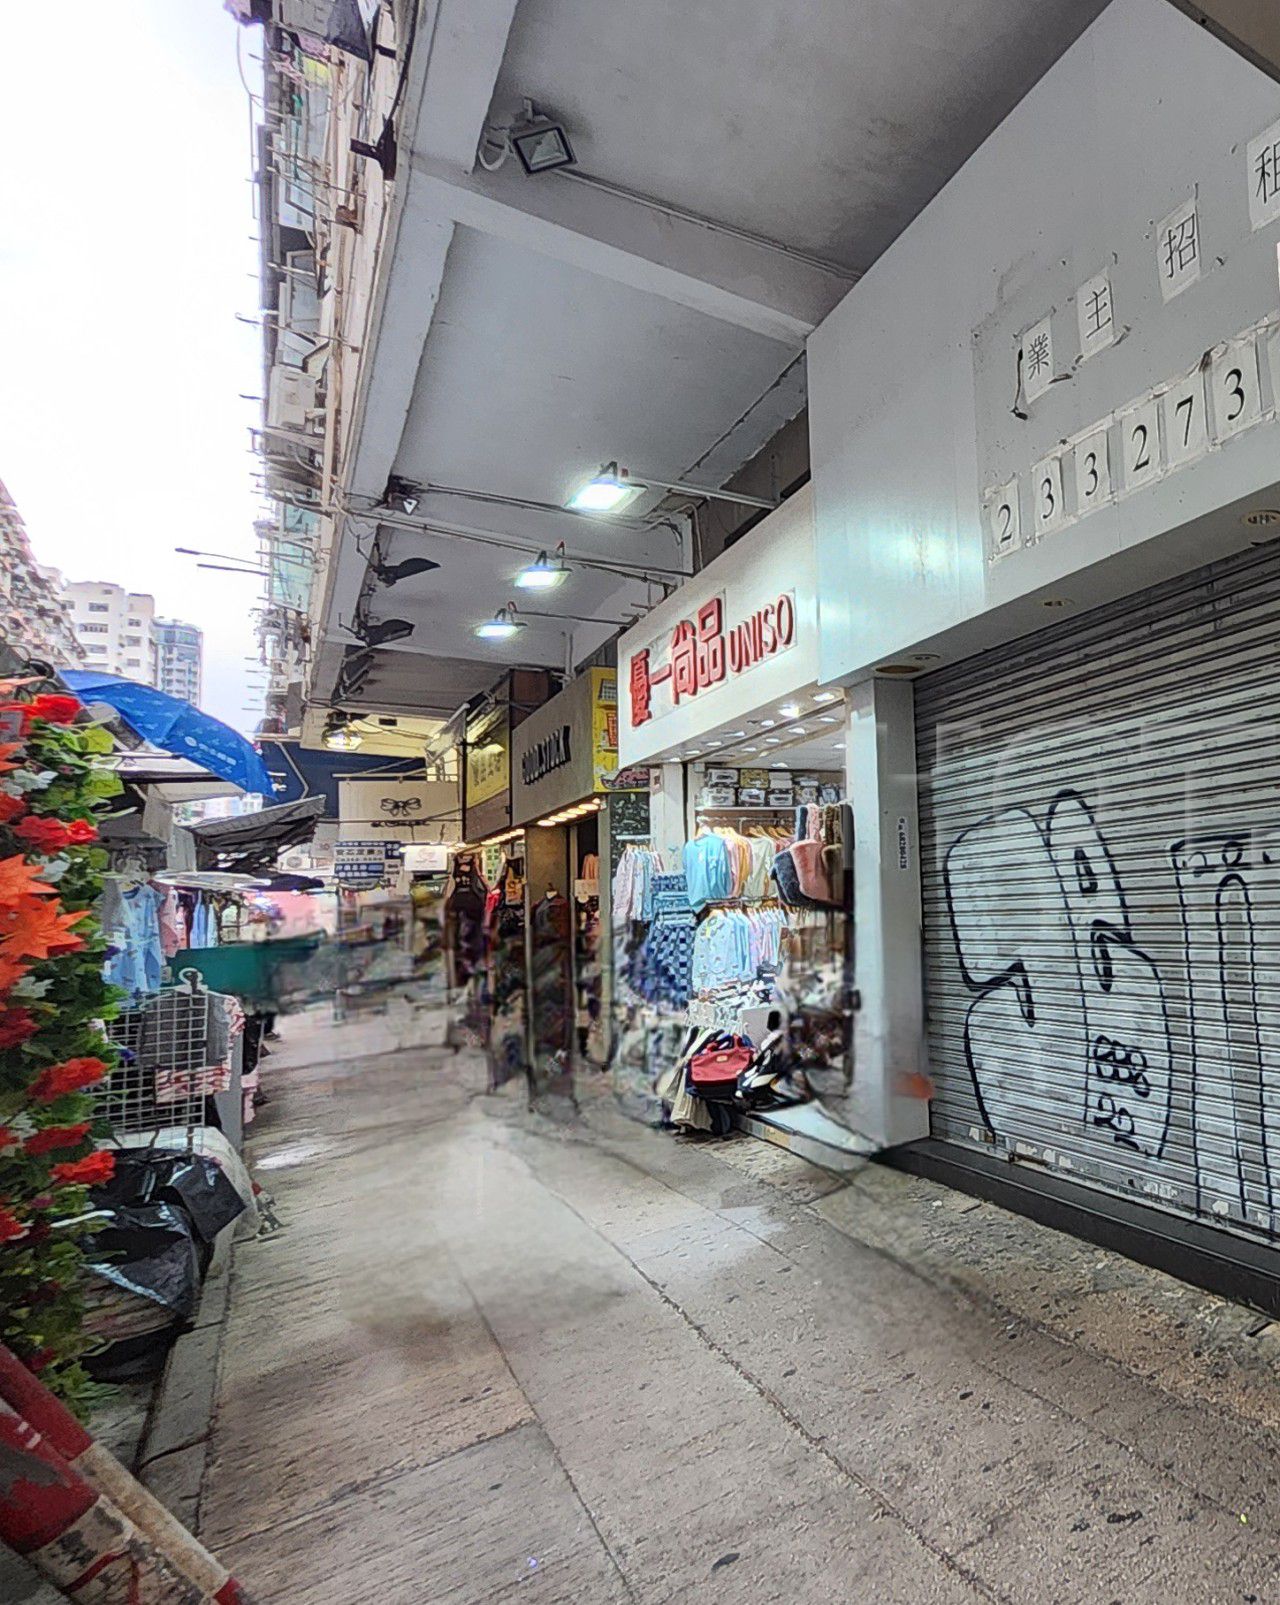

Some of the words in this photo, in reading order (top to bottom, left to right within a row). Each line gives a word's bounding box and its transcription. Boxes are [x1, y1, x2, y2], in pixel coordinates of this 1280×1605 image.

[629, 597, 726, 729] 優一尚品
[728, 593, 796, 674] UNISO
